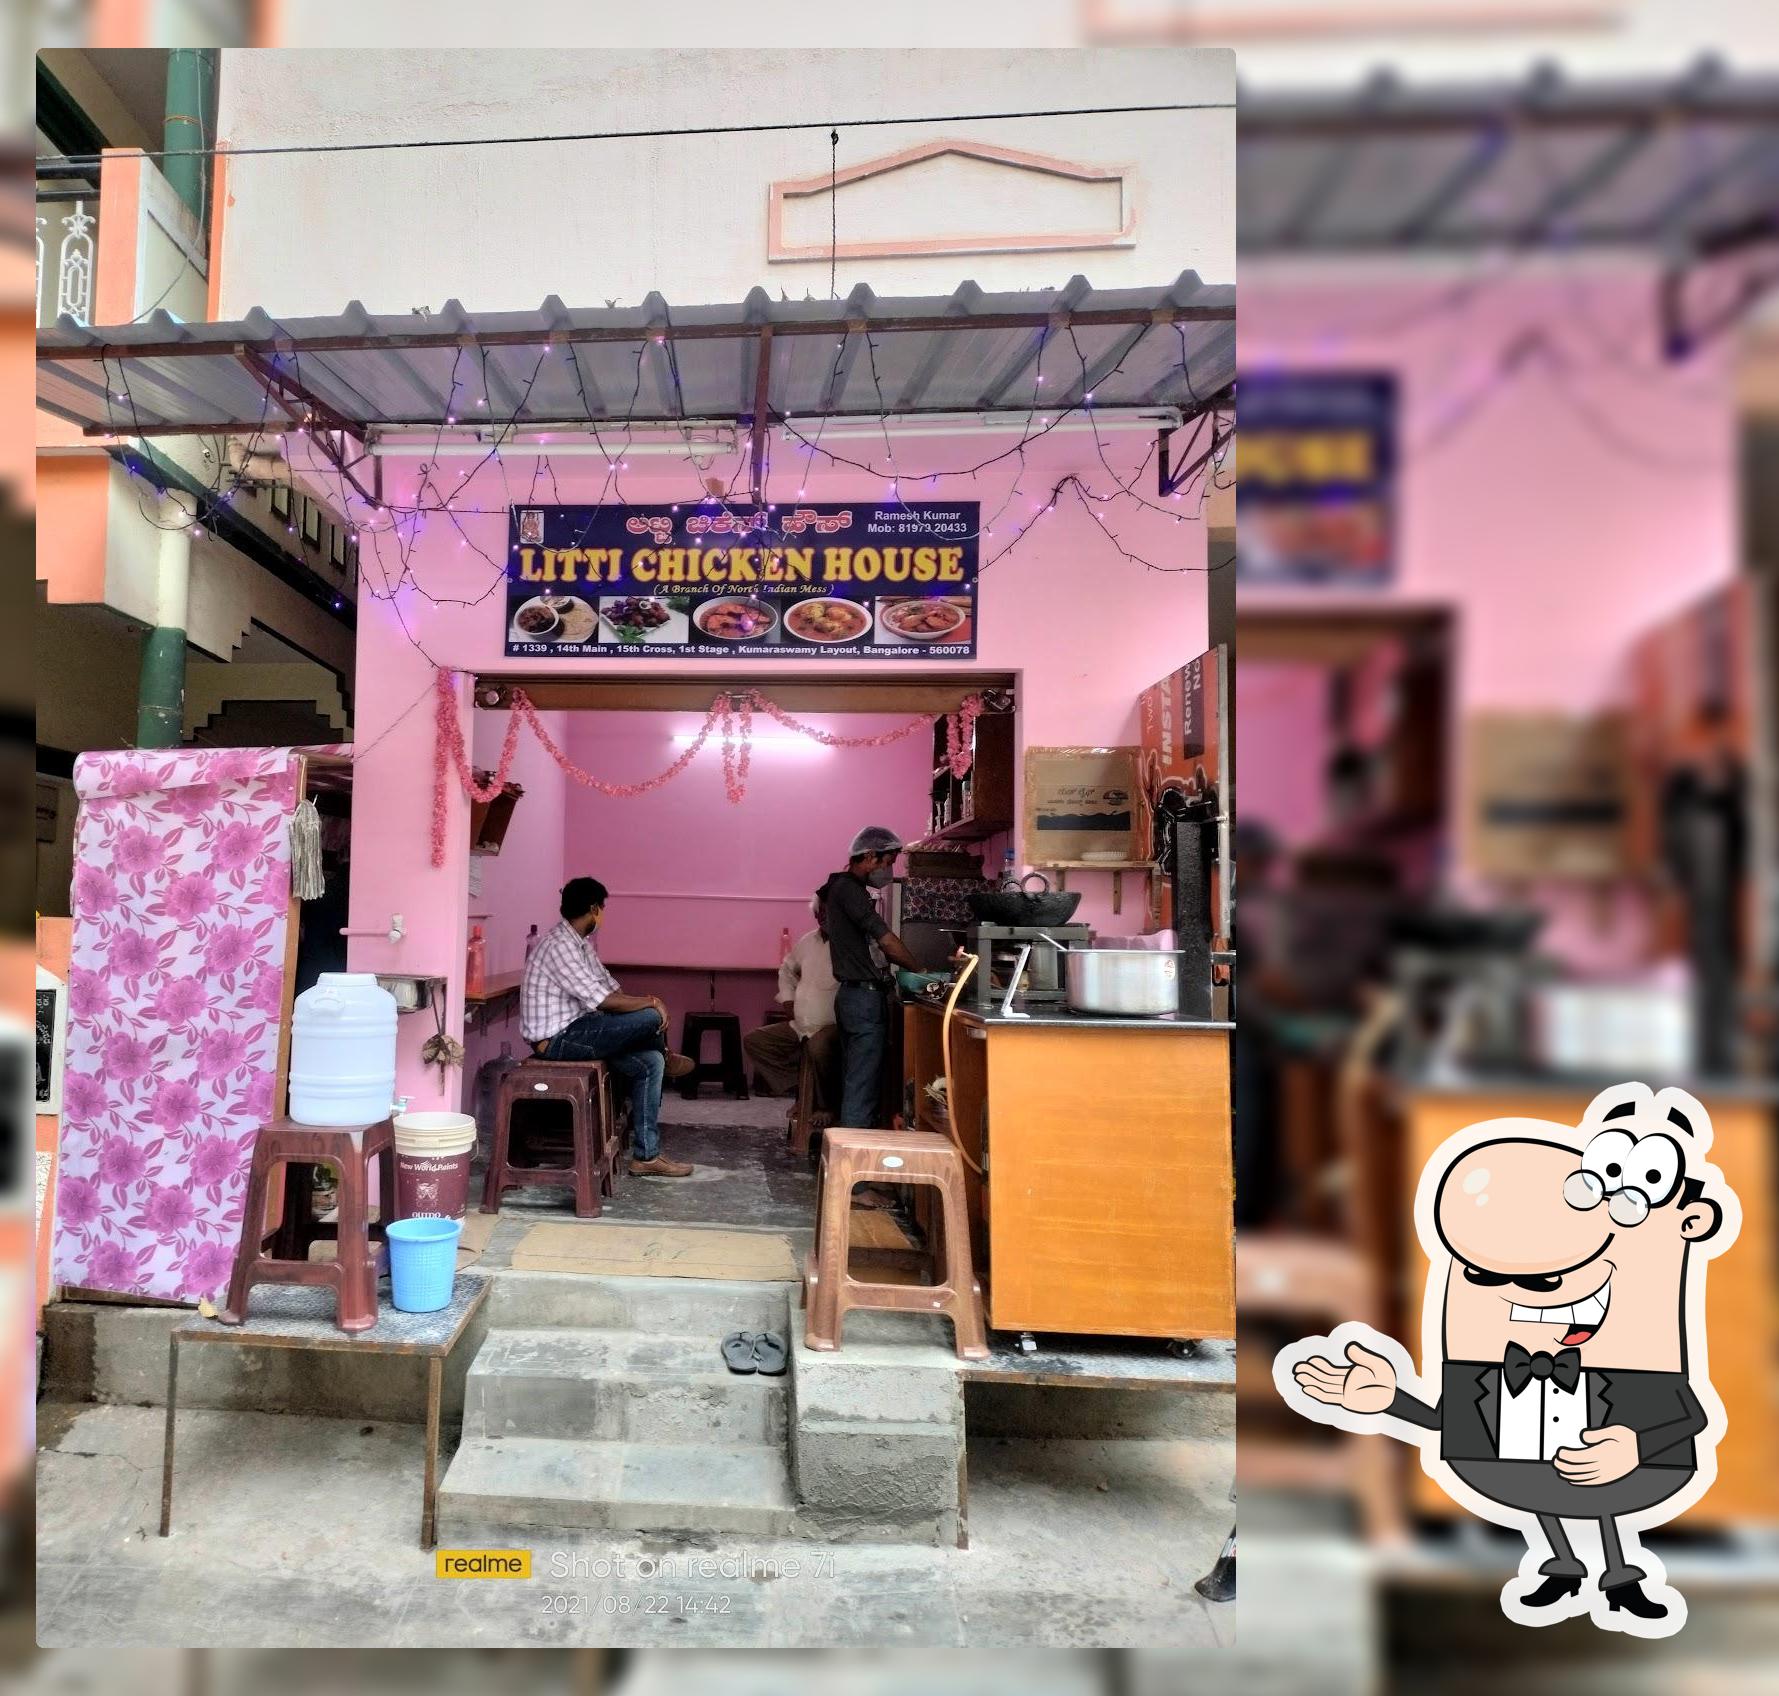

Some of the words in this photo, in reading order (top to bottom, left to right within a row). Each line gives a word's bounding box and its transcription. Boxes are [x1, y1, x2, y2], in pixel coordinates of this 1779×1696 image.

[874, 510, 919, 520] Ramesh
[923, 510, 961, 520] Kumar
[867, 523, 895, 532] Mob:
[898, 523, 931, 532] 81973
[934, 523, 967, 532] 20433
[519, 547, 622, 582] LITTI
[632, 547, 814, 582] CHICKEN
[822, 547, 965, 582] HOUSE
[672, 584, 708, 593] Branch
[711, 584, 725, 595] Of
[556, 644, 579, 652] 14th
[617, 645, 640, 653] 15th
[643, 645, 676, 654] Cross,
[679, 645, 696, 653] 1st
[738, 645, 817, 655] Kumaraswamy
[820, 646, 860, 655] Layout,
[863, 646, 919, 655] Bangalore
[929, 646, 970, 654] 560078
[414, 1163, 437, 1172] World
